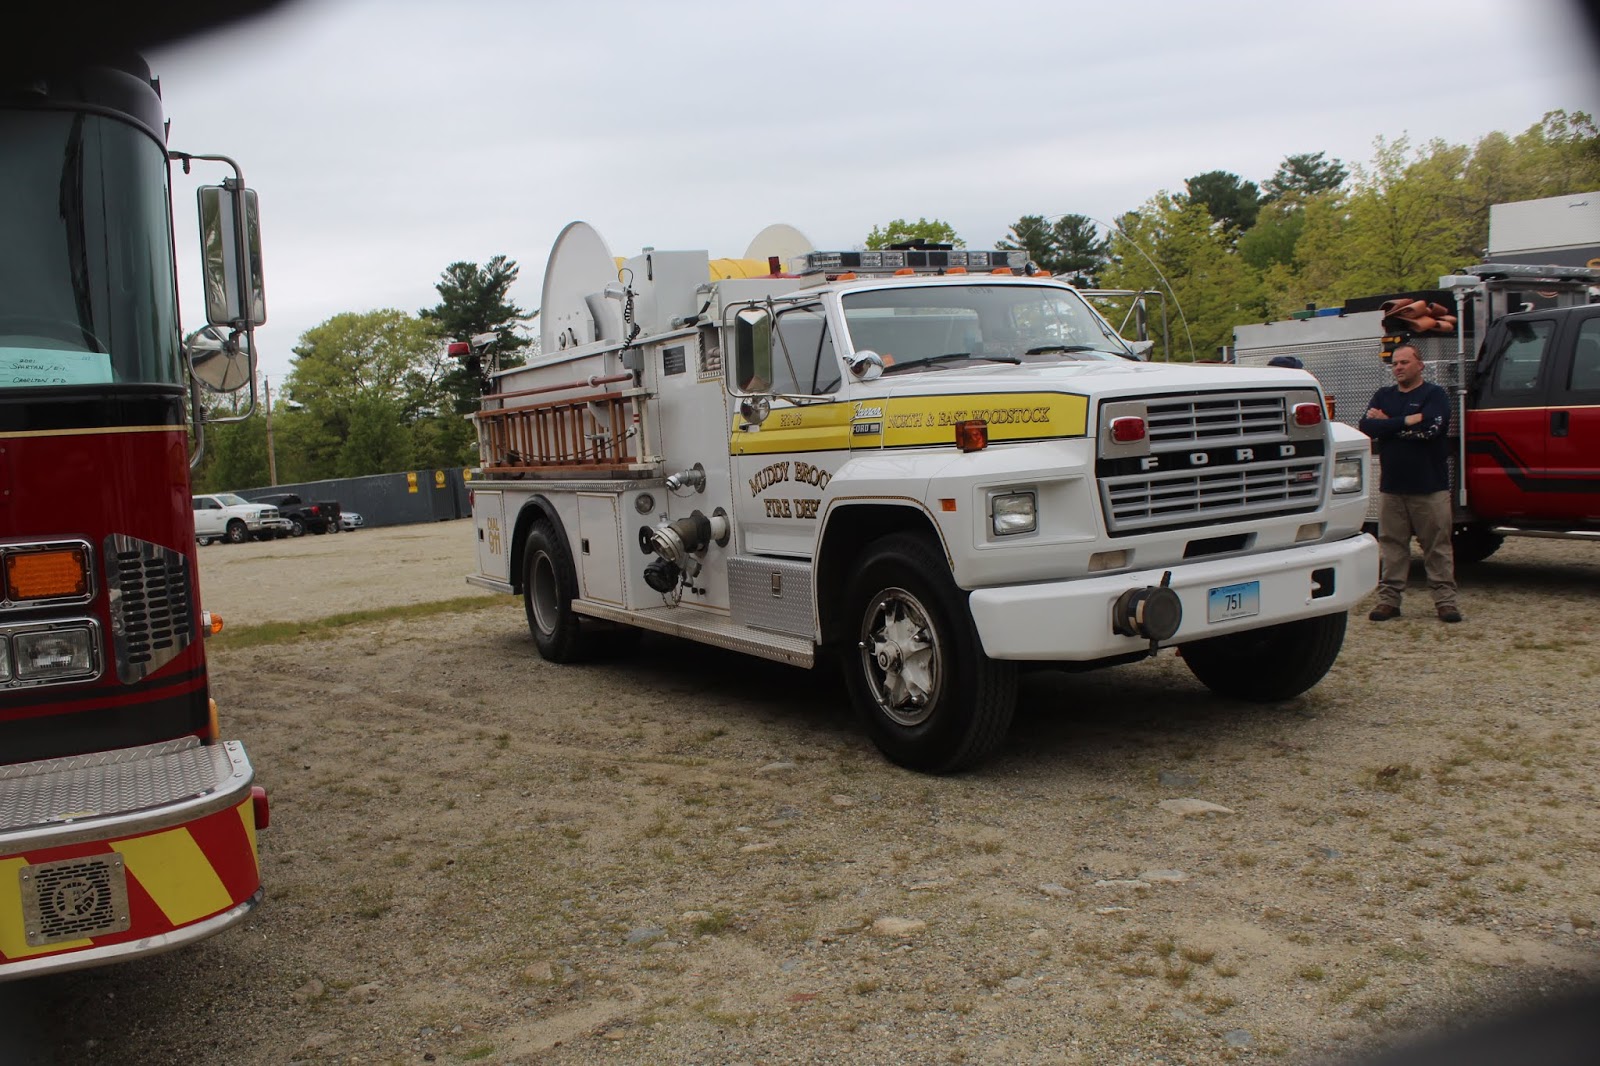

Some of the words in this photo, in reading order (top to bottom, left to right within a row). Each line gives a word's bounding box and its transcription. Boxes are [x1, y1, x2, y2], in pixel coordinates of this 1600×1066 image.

[852, 424, 870, 433] FORD
[887, 412, 922, 429] NORTH
[925, 414, 935, 427] &
[938, 411, 967, 426] EAST
[971, 407, 1051, 425] WOODSTOCK
[1140, 444, 1296, 471] FORD
[748, 461, 790, 498] MUDDY
[794, 461, 833, 491] BROO
[763, 498, 792, 518] FIRE
[793, 498, 822, 519] DEP
[488, 530, 502, 556] 911
[1224, 592, 1242, 611] 751
